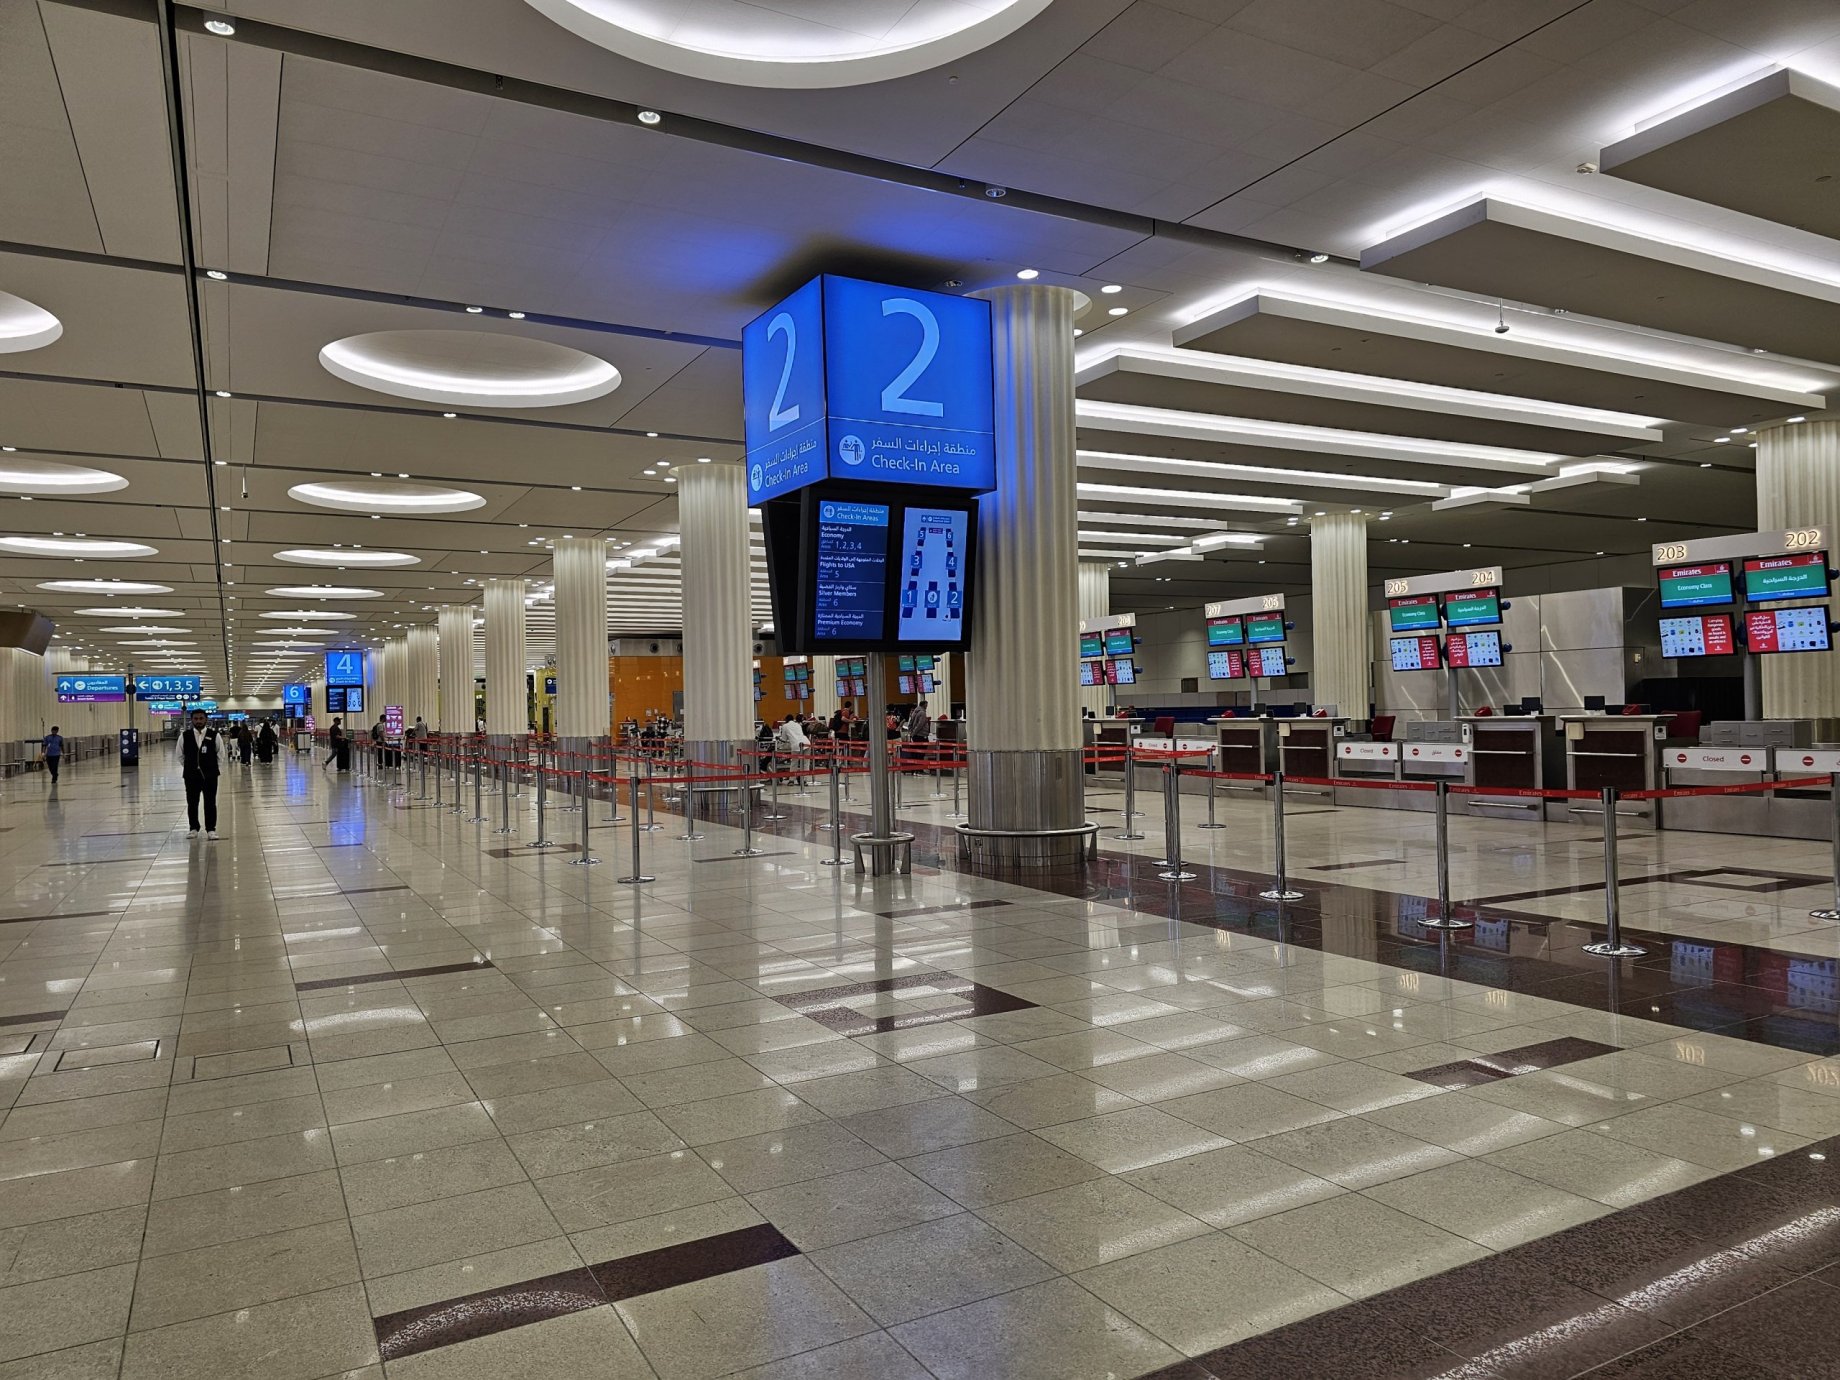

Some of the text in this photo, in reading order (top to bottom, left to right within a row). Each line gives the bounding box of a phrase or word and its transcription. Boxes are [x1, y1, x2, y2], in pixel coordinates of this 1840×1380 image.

[882, 298, 944, 417] 2
[768, 312, 800, 432] 2
[800, 440, 817, 454] منطقة
[870, 437, 976, 456] منطقة إجراءات السفر
[872, 454, 960, 474] Check-In Area
[765, 462, 808, 488] Check-In Area
[1786, 530, 1819, 548] 202
[914, 555, 920, 565] 3
[1657, 546, 1686, 560] 203
[948, 557, 954, 566] 4
[1760, 559, 1792, 568] Emirates
[1472, 571, 1495, 585] 204
[1672, 569, 1702, 577] Emirates
[1387, 581, 1408, 594] 205
[907, 591, 912, 602] 1
[951, 591, 958, 603] 2
[1207, 605, 1221, 616] 207
[336, 654, 353, 674] 4
[290, 686, 299, 698] 6
